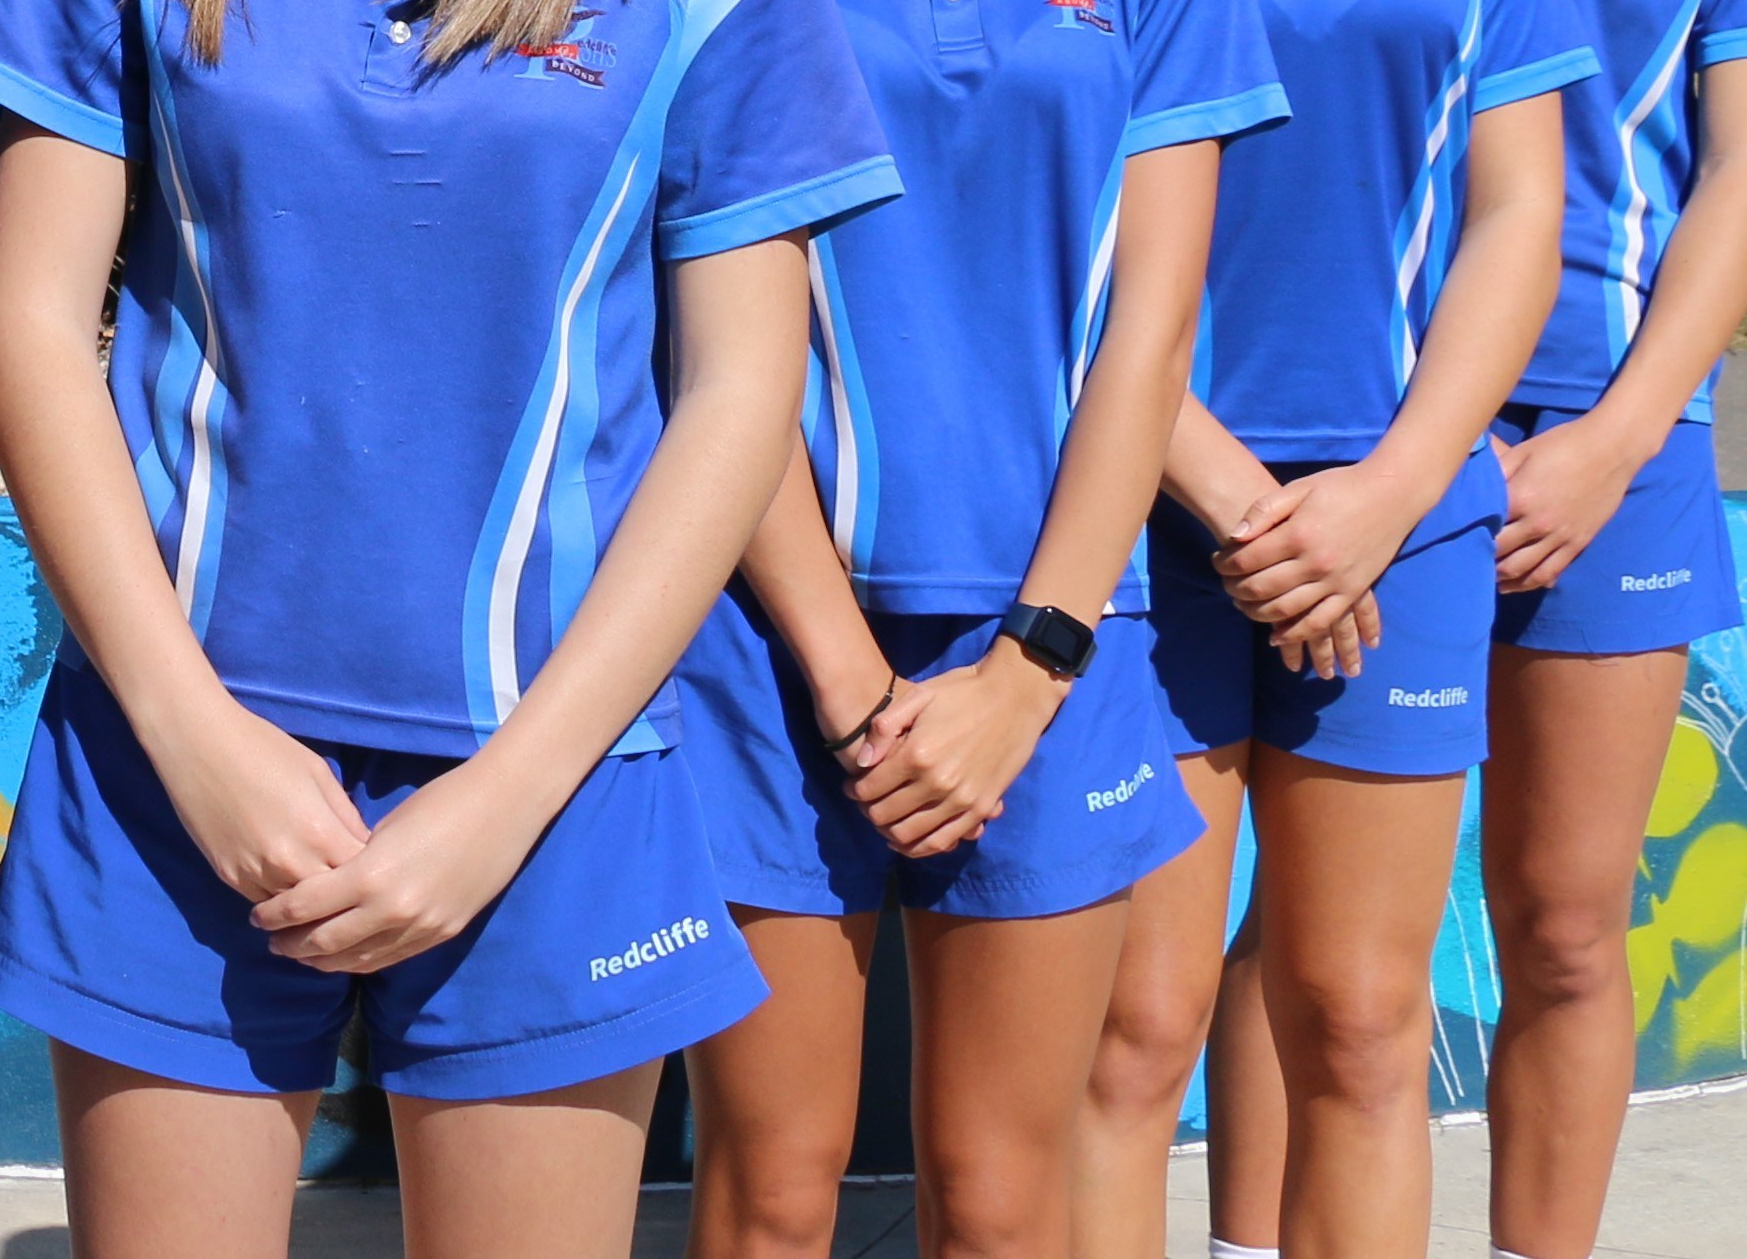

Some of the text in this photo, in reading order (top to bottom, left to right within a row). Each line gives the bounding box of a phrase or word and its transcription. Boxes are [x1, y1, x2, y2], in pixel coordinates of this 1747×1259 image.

[551, 60, 595, 82] BEYOND
[1388, 686, 1469, 708] Redcliffe
[589, 916, 710, 982] Redcliffe
